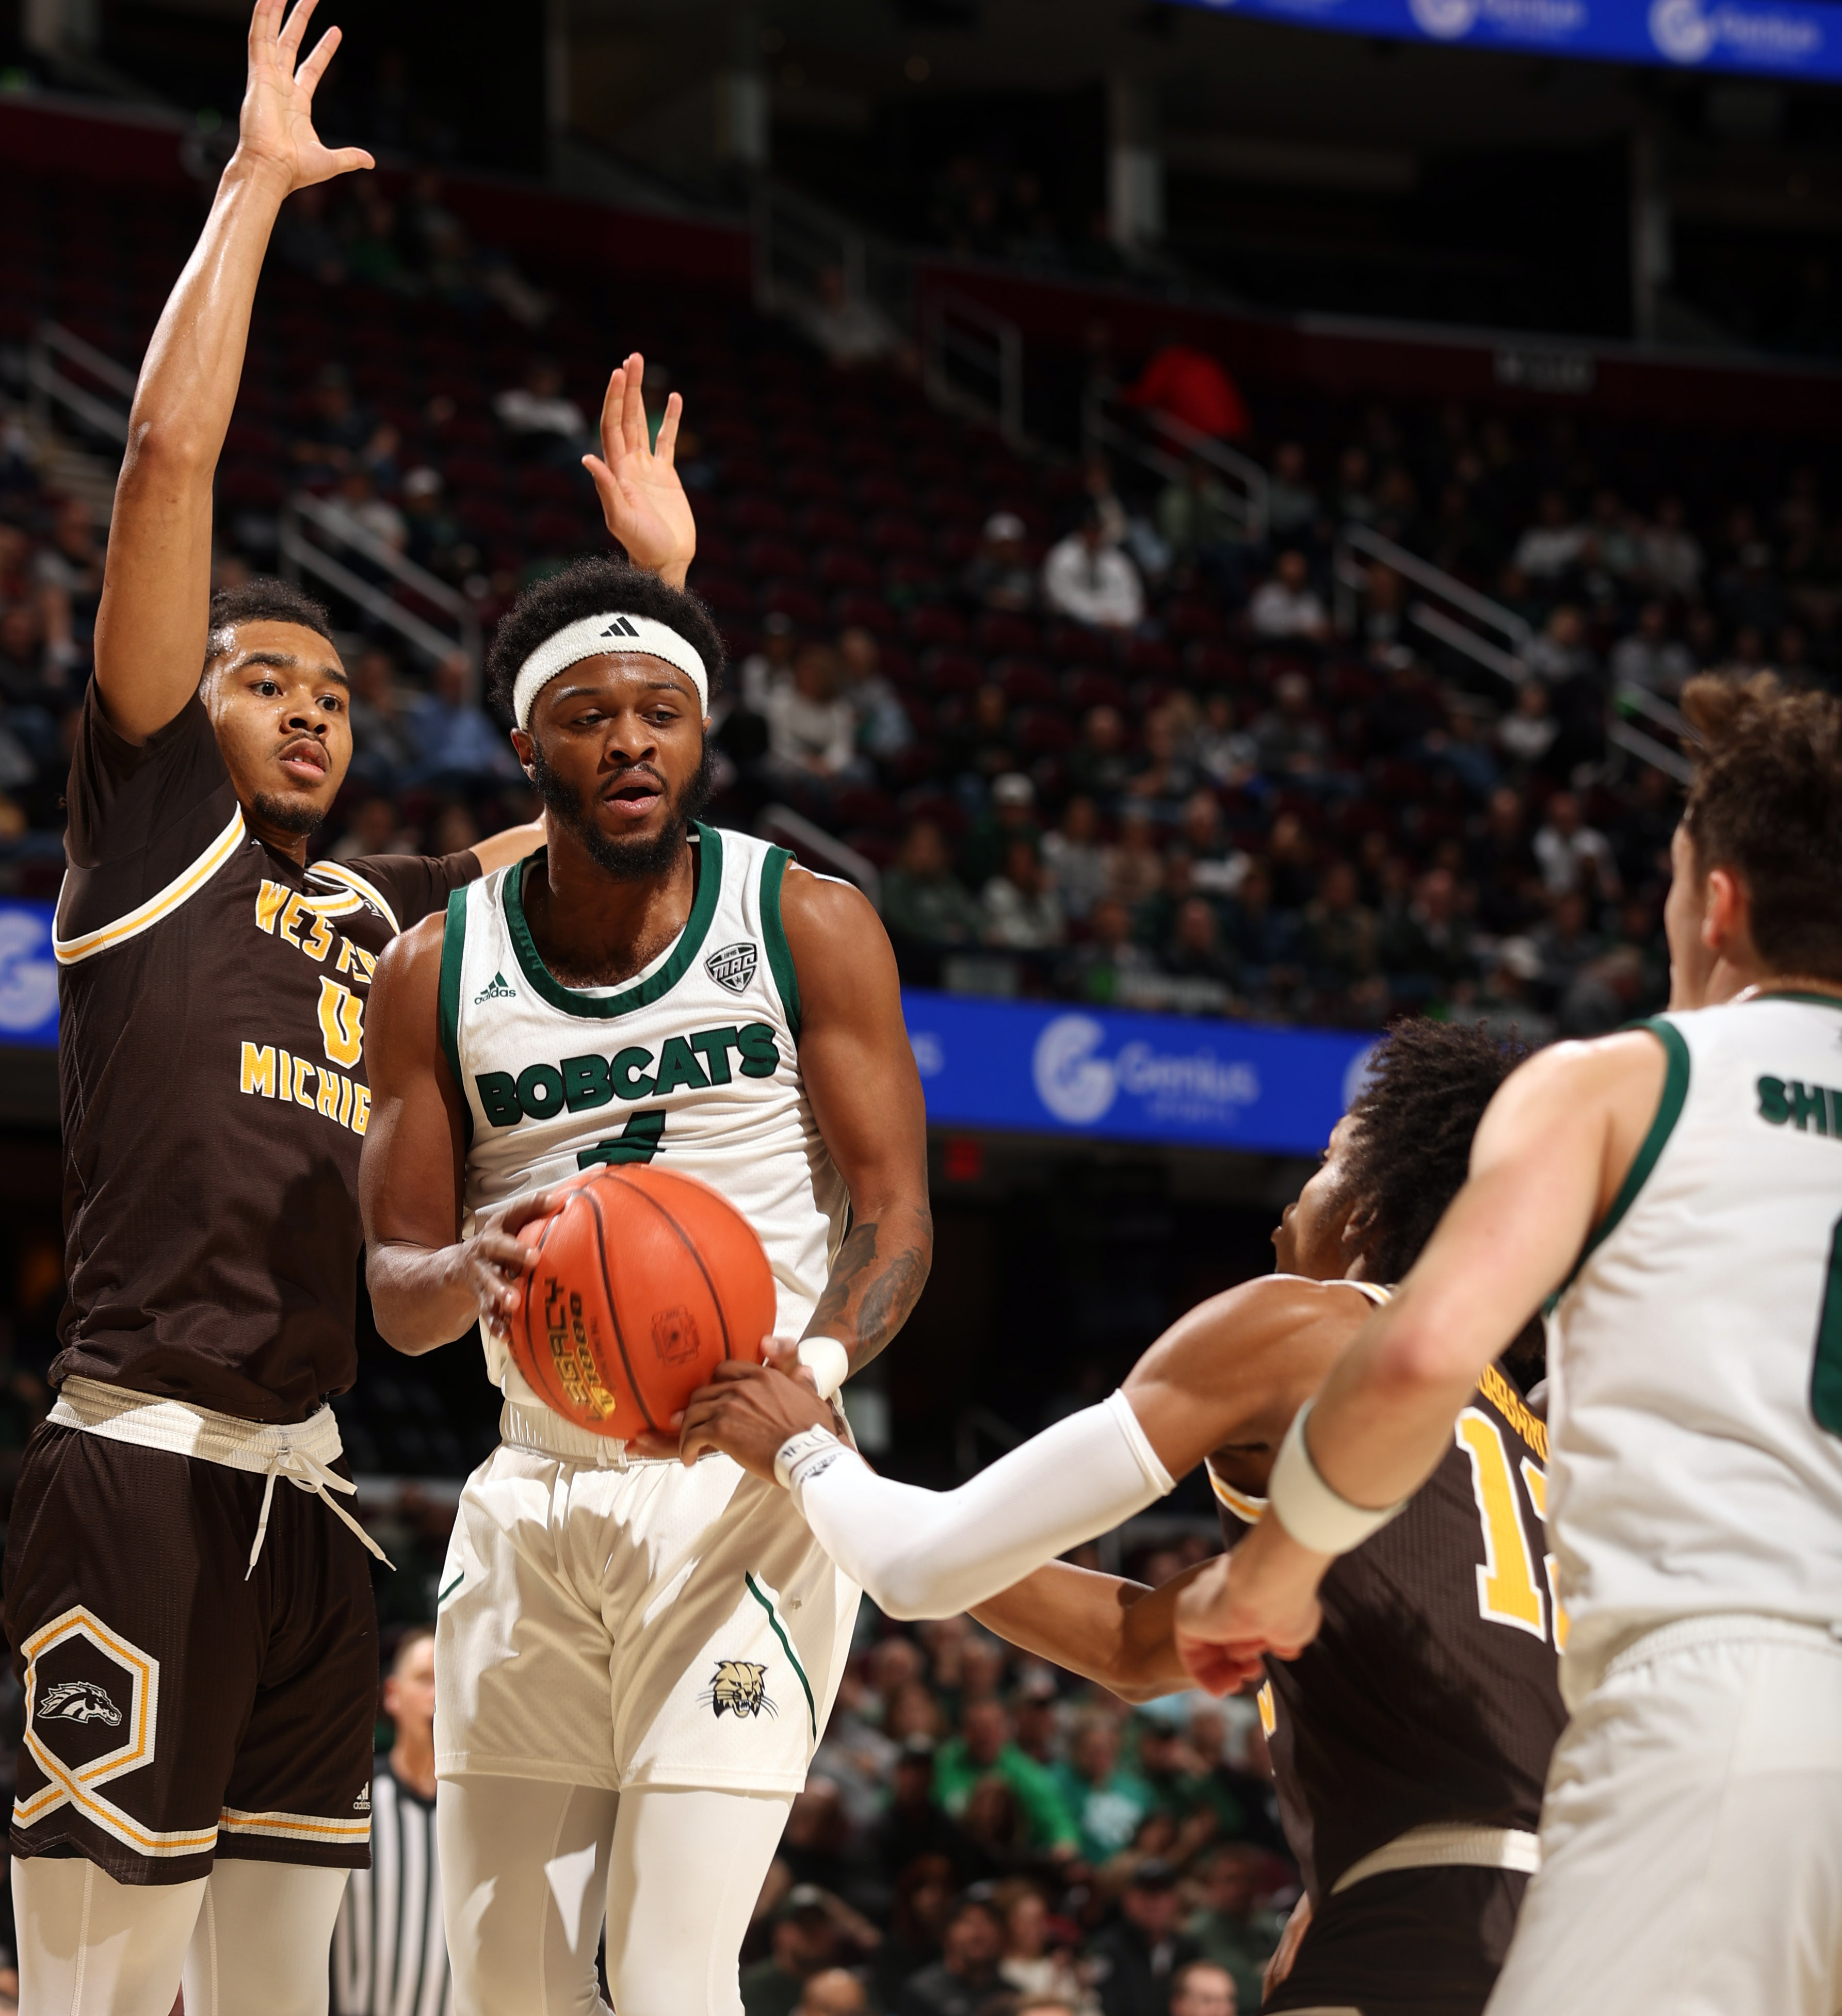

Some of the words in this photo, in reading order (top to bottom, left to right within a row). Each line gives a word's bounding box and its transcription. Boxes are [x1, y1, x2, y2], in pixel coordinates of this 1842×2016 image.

[255, 879, 379, 984] WESTER
[712, 953, 756, 980] MAC
[474, 986, 516, 1005] adidas
[240, 1041, 371, 1136] MICHIG
[475, 1022, 780, 1128] BOBCATS
[1118, 1041, 1259, 1105] Genius
[544, 1276, 606, 1422] LEGACY
